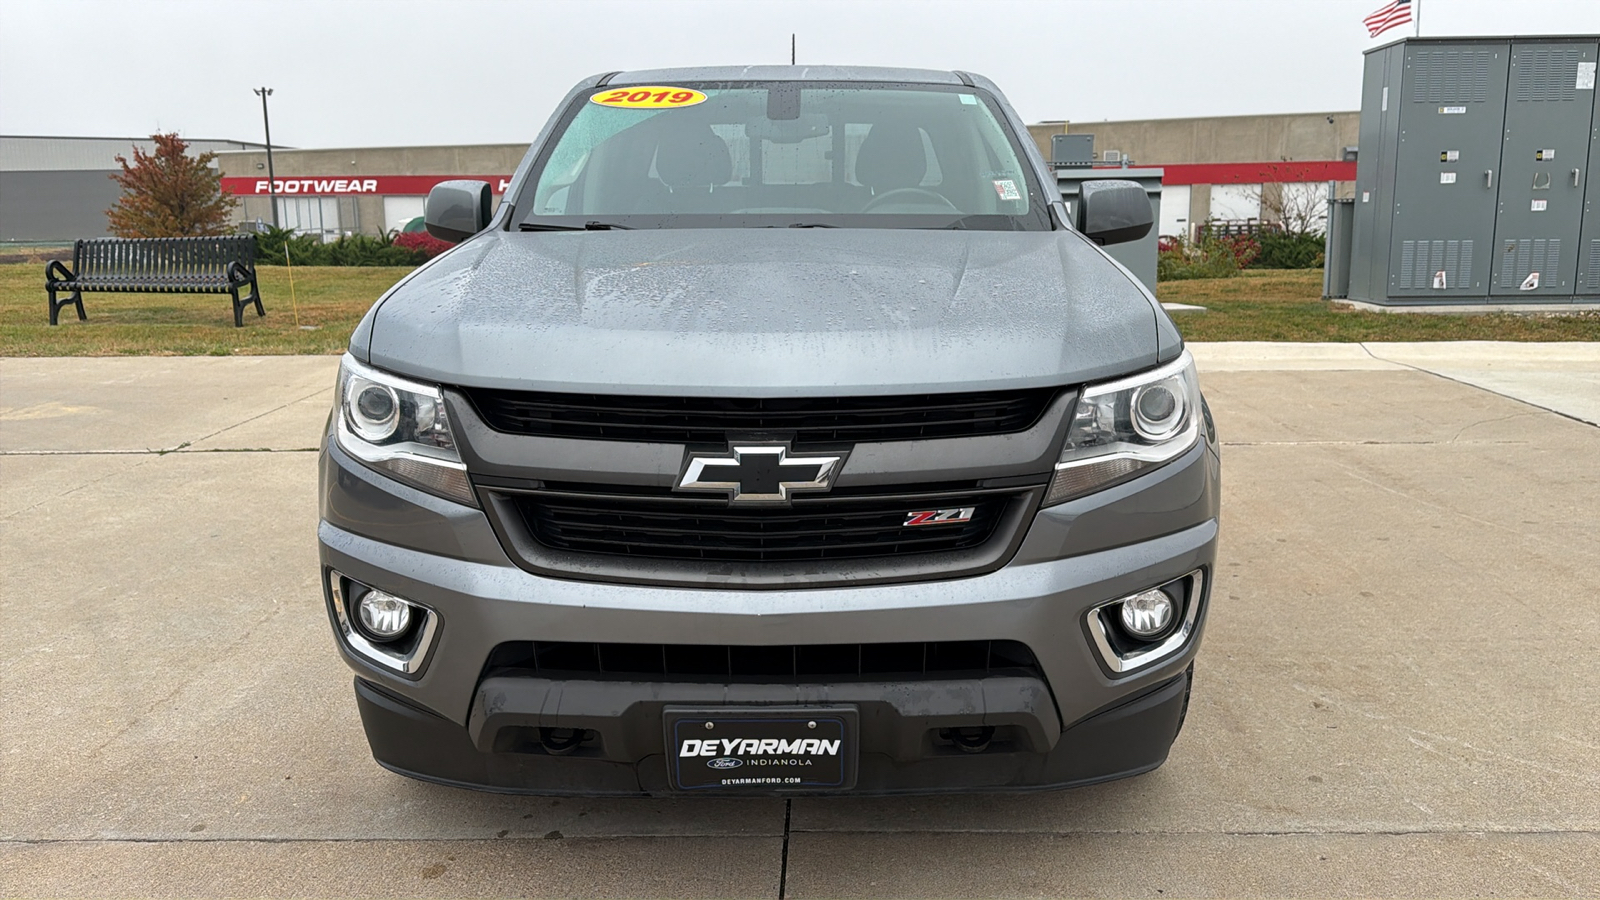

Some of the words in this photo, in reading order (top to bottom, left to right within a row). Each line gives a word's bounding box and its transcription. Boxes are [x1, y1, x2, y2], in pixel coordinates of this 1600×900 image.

[602, 91, 694, 103] 2019
[255, 179, 377, 193] FOOTWEAR
[903, 507, 975, 526] Z71
[711, 758, 739, 768] Ford
[721, 777, 801, 785] DEYARMANFORD.COM
